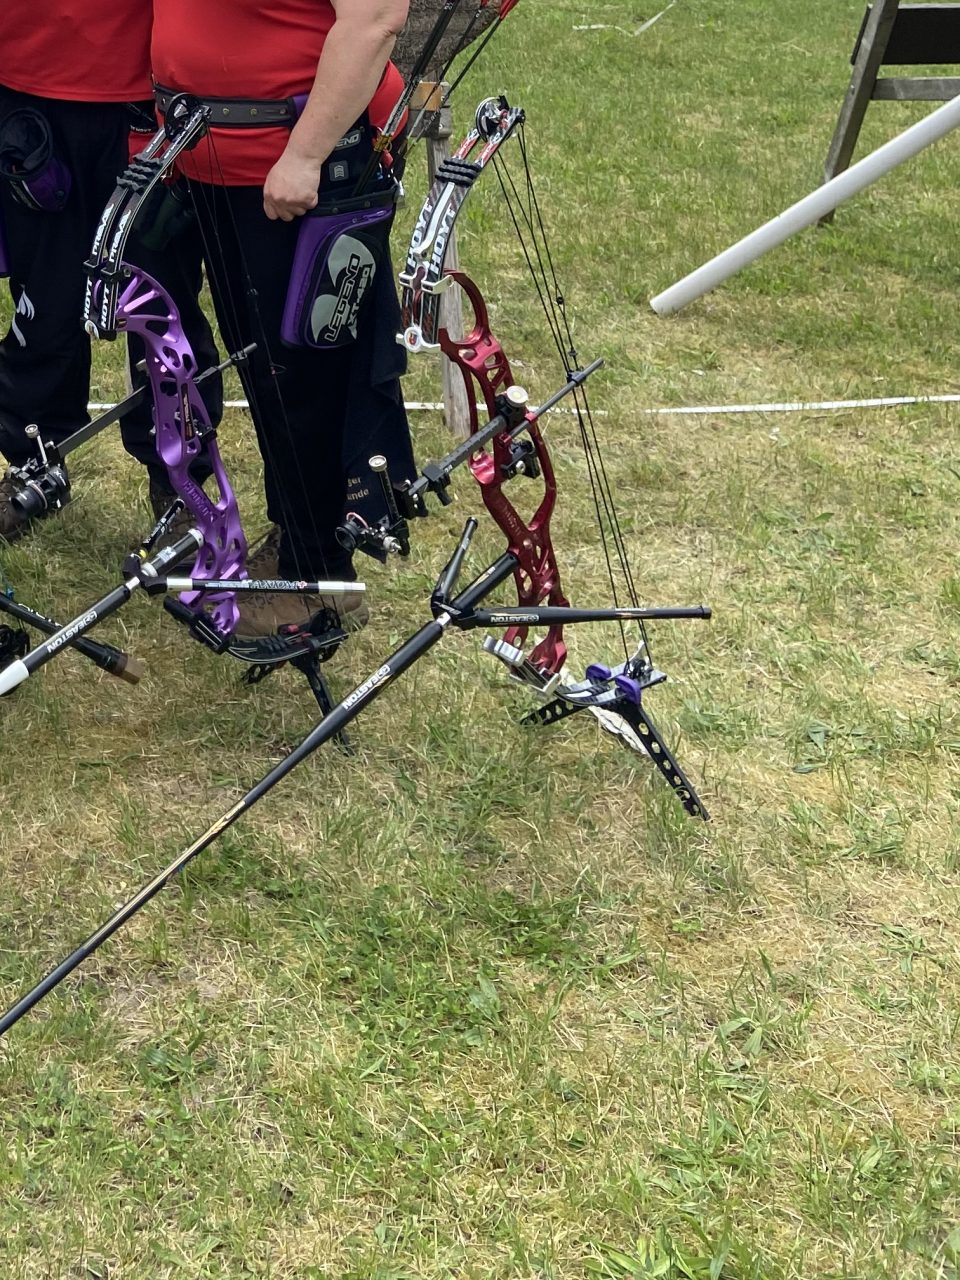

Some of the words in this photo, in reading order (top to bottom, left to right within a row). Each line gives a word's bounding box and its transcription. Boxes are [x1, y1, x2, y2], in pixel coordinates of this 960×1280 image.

[407, 198, 433, 268] HOYT
[430, 203, 456, 274] HOYT
[84, 276, 93, 320] HOYT
[101, 283, 110, 328] HOYT
[324, 253, 361, 342] LEGEND
[47, 620, 86, 653] EASTON
[490, 614, 529, 623] EASTON
[342, 673, 380, 710] EASTON
